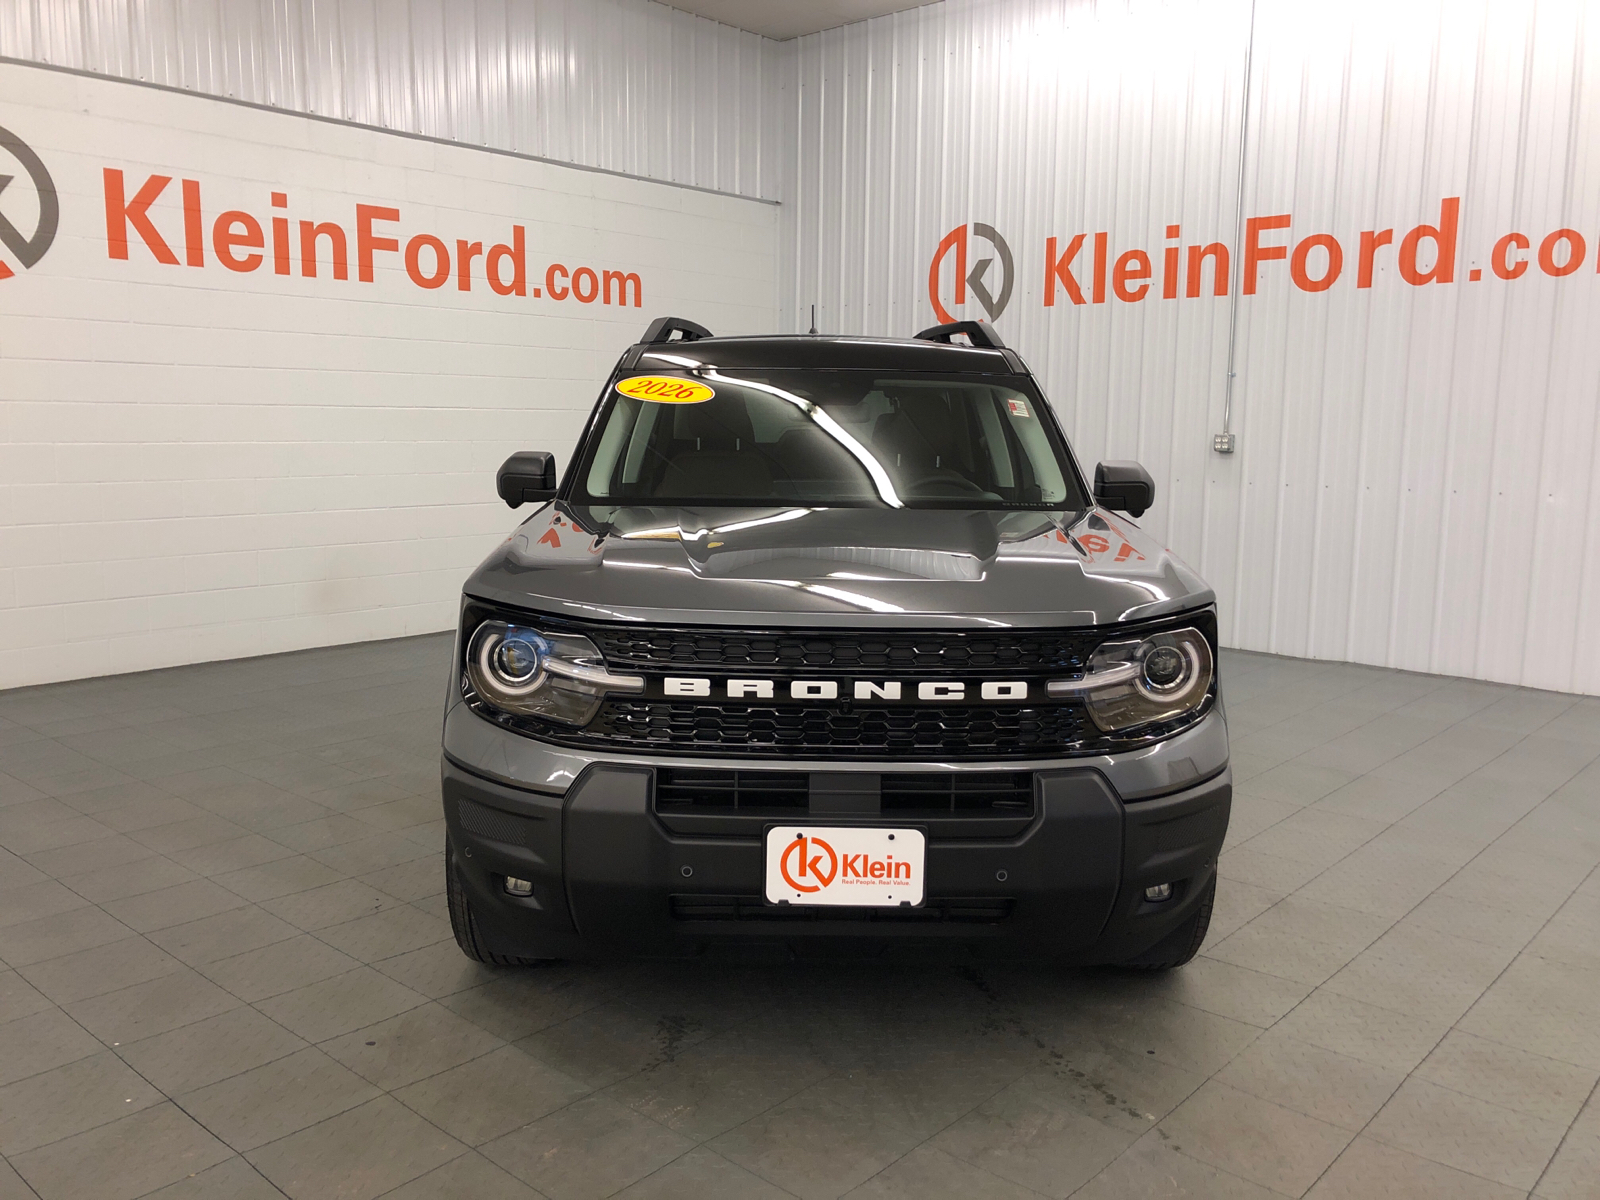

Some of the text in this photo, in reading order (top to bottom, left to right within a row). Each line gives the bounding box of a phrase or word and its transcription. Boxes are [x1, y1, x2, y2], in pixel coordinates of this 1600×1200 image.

[104, 167, 642, 308] KleinFord.com
[1043, 197, 1600, 307] KleinFord.co
[627, 380, 702, 399] 2026
[664, 677, 1028, 701] BRONCO
[842, 854, 911, 879] Klein
